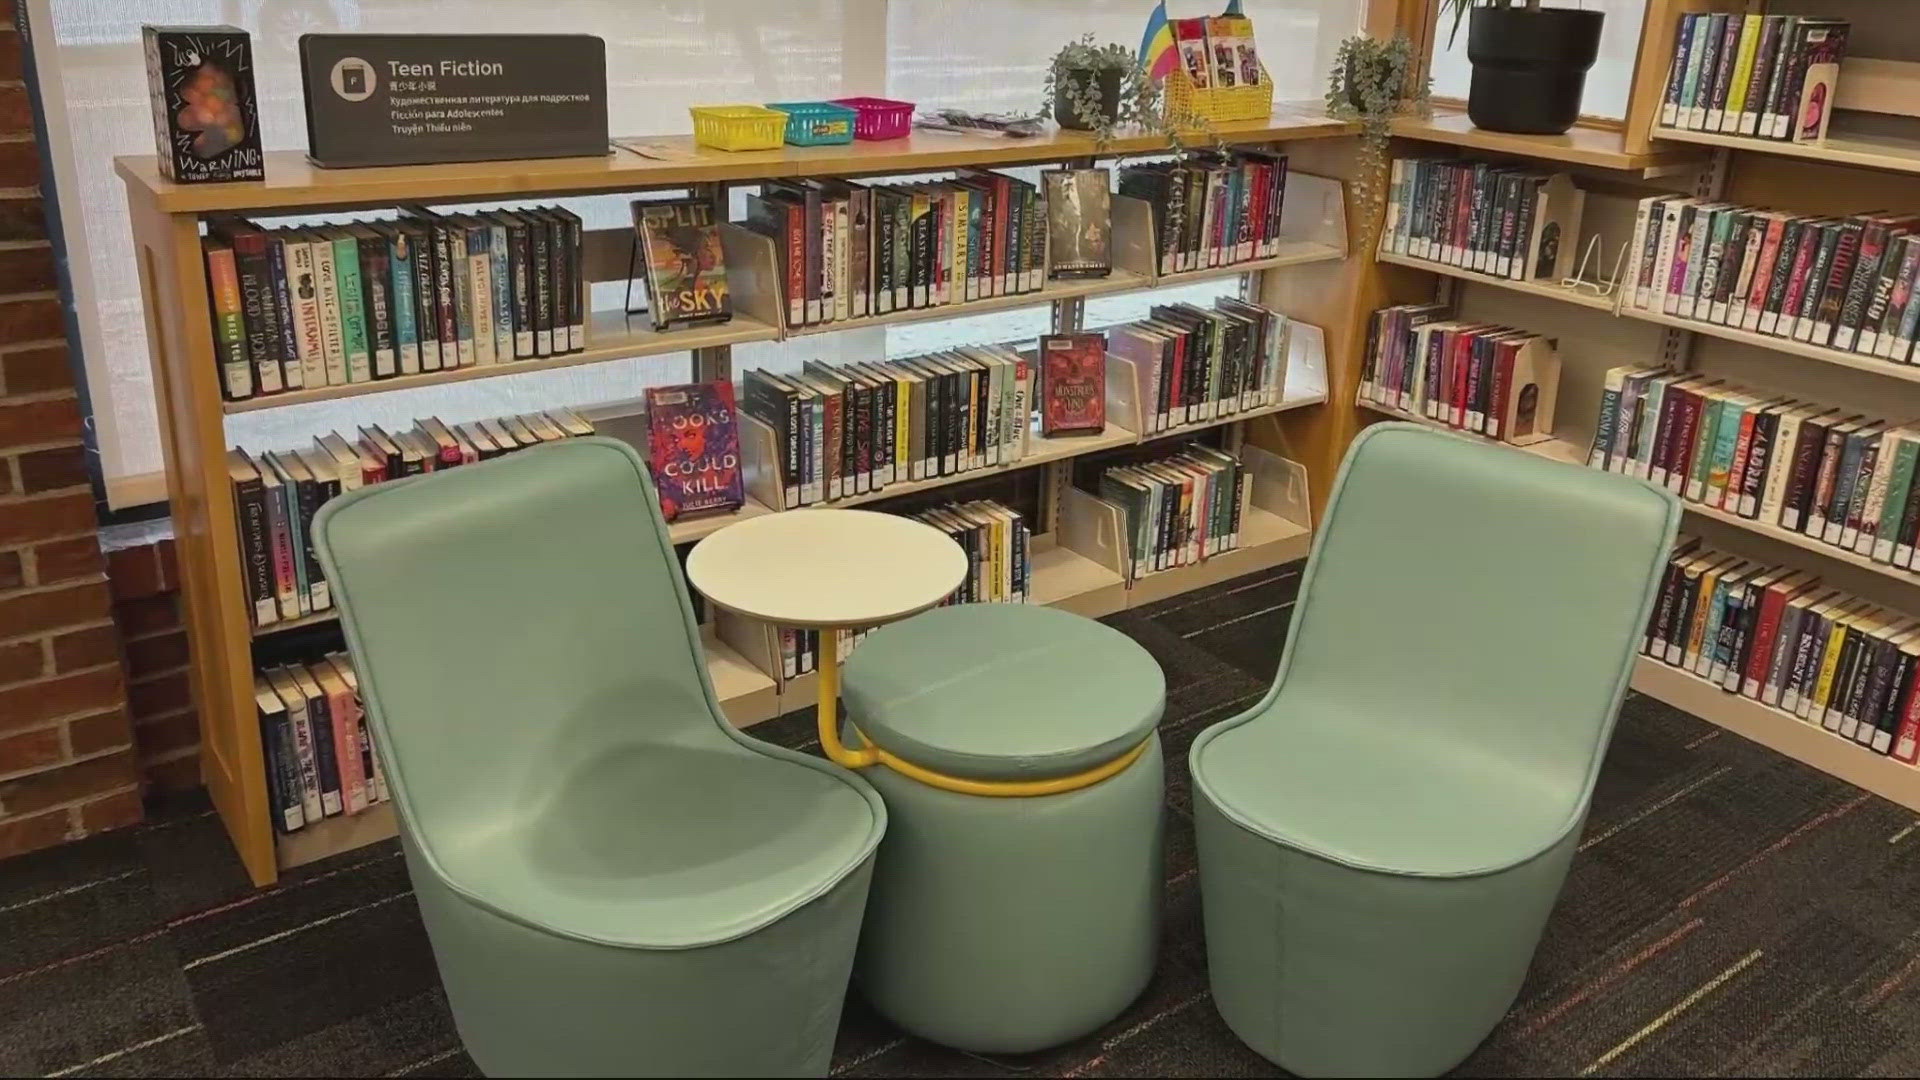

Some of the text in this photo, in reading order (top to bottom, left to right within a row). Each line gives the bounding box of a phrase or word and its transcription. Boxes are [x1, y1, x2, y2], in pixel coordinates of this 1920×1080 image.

[388, 60, 503, 76] Teen Fiction
[425, 111, 445, 120] para
[447, 109, 504, 119] Adolescentes
[469, 95, 521, 105] литература
[522, 95, 539, 104] для
[541, 94, 590, 104] подростков
[919, 219, 927, 258] BEASTS
[956, 204, 969, 266] SIMILARS
[918, 269, 926, 287] WA
[1702, 241, 1725, 300] LAKELOR
[680, 288, 725, 313] SKY
[1867, 277, 1895, 320] Pritty
[243, 275, 266, 361] BLOOD BON
[302, 301, 321, 360] INTERNME
[374, 284, 391, 351] FLEDGLIN
[672, 409, 730, 430] OOKS
[1597, 392, 1618, 437] RAMONA
[664, 455, 737, 477] COULD
[682, 476, 725, 495] KILL
